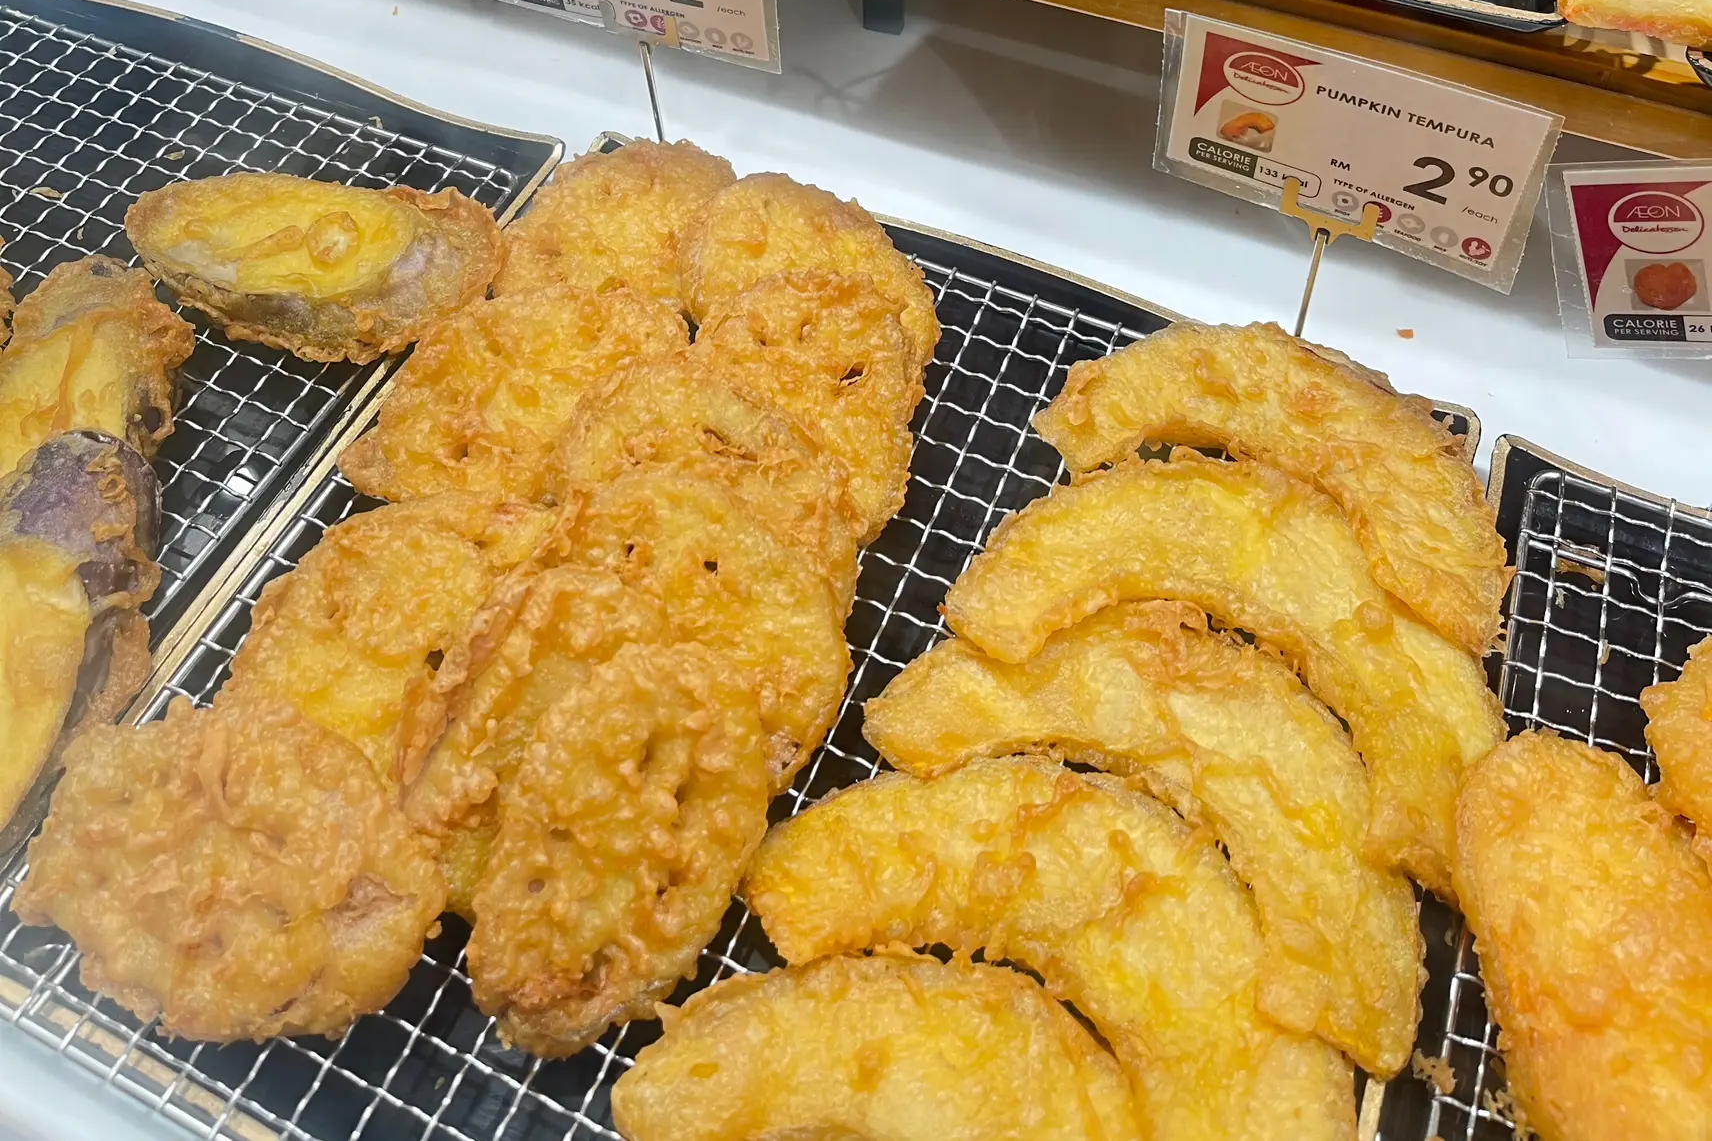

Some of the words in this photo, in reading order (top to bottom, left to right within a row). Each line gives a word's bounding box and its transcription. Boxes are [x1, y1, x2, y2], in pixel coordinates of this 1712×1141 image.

[620, 0, 636, 8] TYPE
[649, 6, 686, 19] ALLERGEN
[1316, 85, 1402, 119] PUMPKIN
[1407, 112, 1495, 149] TEMPURA
[1195, 149, 1211, 158] PER
[1212, 155, 1250, 171] SERVING
[1197, 142, 1252, 165] CALORIE
[1259, 166, 1279, 178] 133
[1330, 158, 1351, 171] RM
[1333, 178, 1354, 190] TYPE
[1355, 186, 1369, 195] OF
[1370, 190, 1415, 212] ALLERGEN
[1461, 206, 1499, 225] /each
[1612, 319, 1678, 329] CALORIE
[1688, 324, 1706, 333] 26
